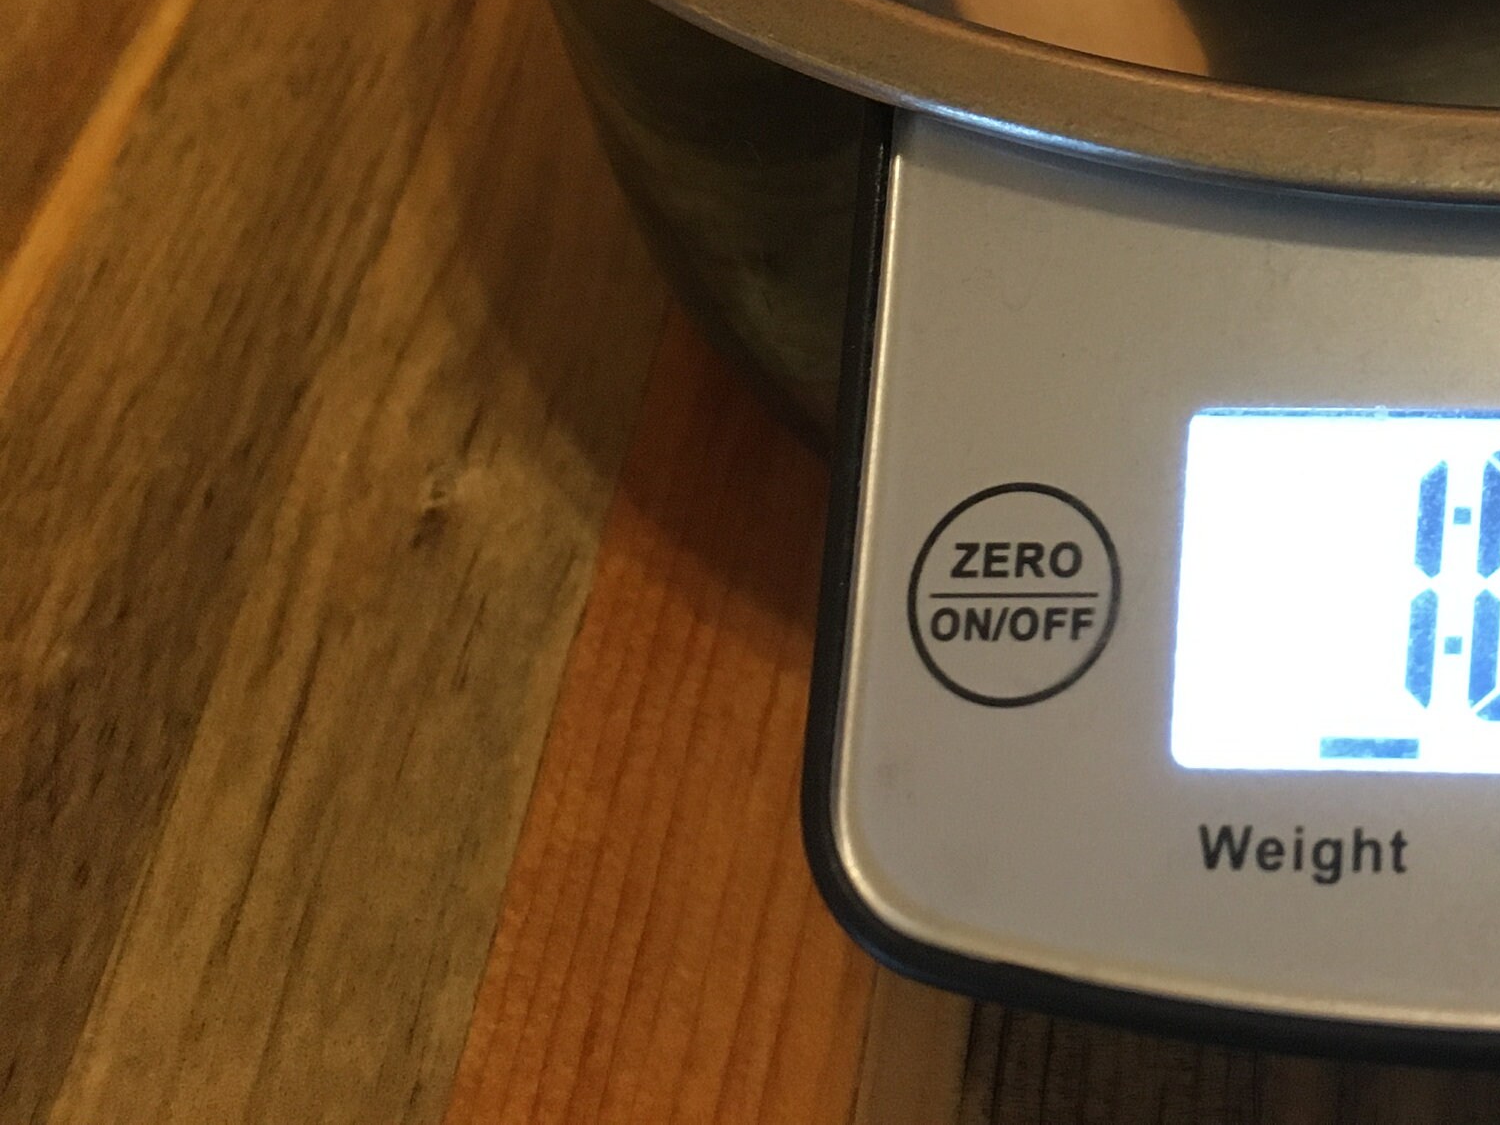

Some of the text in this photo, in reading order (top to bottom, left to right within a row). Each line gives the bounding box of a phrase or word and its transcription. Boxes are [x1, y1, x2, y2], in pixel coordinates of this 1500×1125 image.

[950, 542, 1083, 578] ZERO
[930, 607, 1096, 642] ON/OFF
[1199, 824, 1409, 885] Weight
